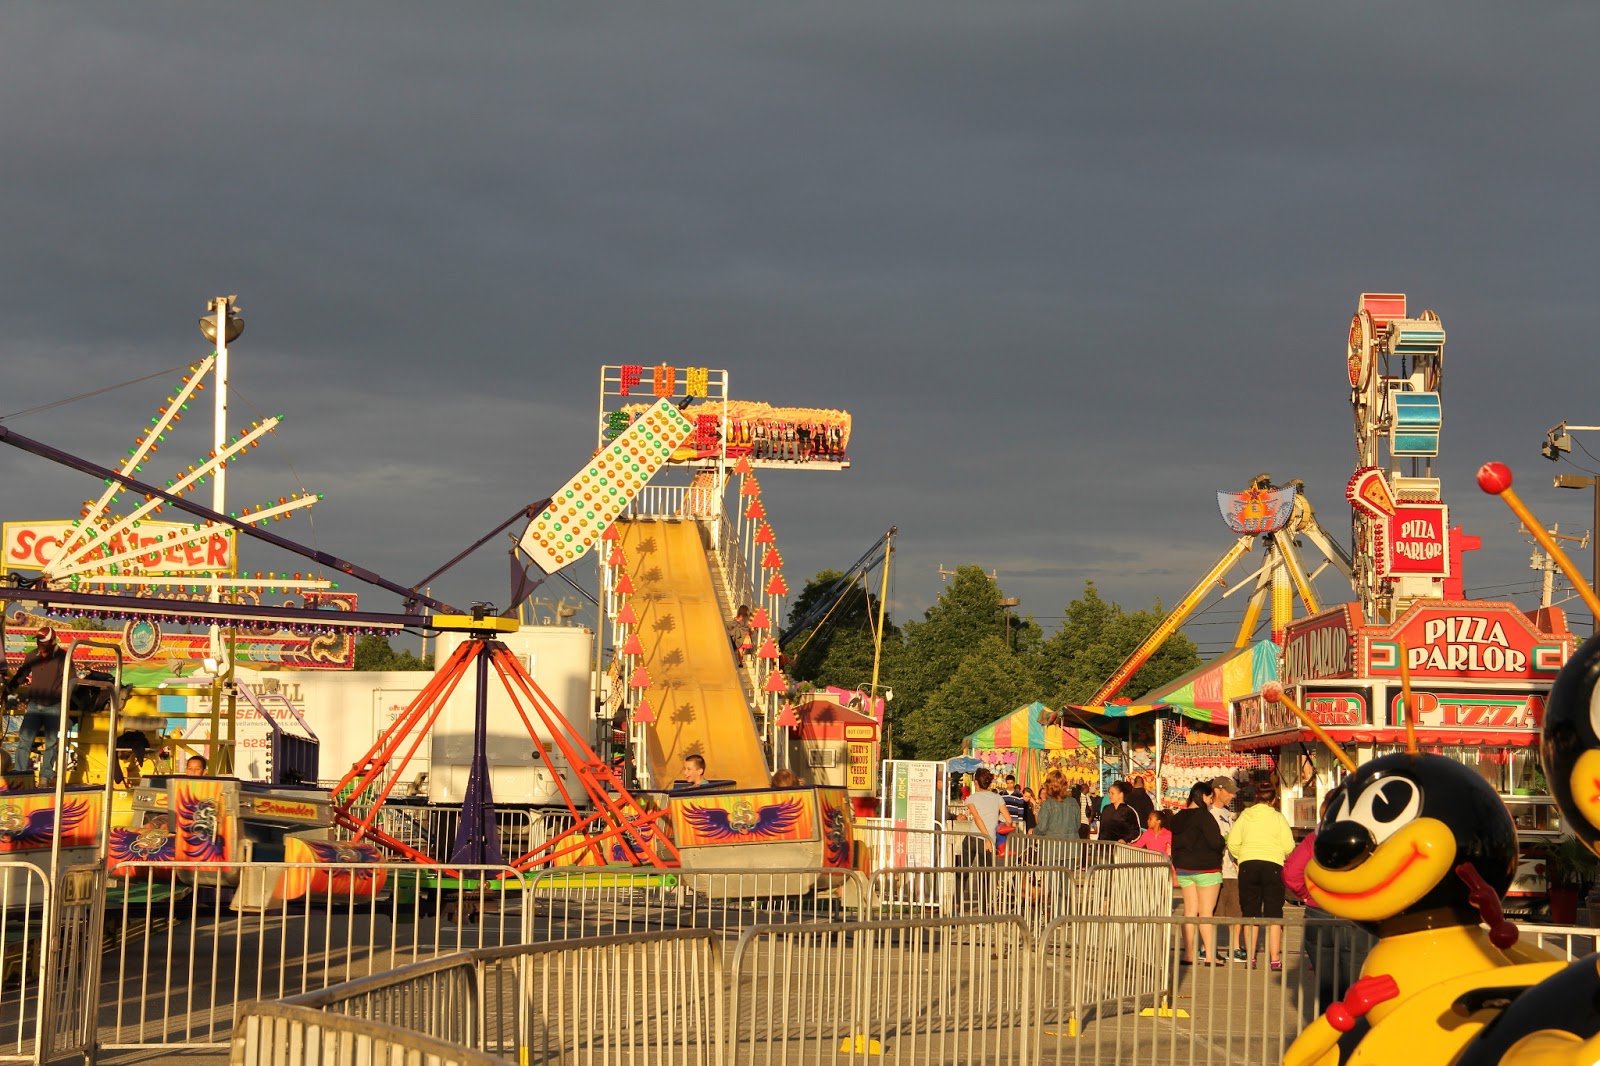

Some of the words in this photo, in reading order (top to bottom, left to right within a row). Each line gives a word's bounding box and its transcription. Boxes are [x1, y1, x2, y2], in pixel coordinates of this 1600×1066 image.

[619, 364, 709, 398] FUN
[1400, 519, 1436, 540] PIZZA
[1395, 540, 1443, 561] PARLOR
[1424, 616, 1510, 648] PIZZA
[1309, 626, 1347, 680] PARLOR
[1407, 643, 1527, 673] PARLOR
[1309, 698, 1349, 713] COLD
[1402, 692, 1547, 728] PIZZA
[850, 744, 869, 754] JERRY'S
[850, 765, 868, 775] CHEESE
[852, 776, 866, 785] FRIES
[897, 777, 907, 800] YES
[255, 801, 315, 817] Scrambler
[65, 876, 93, 901] EXIT
